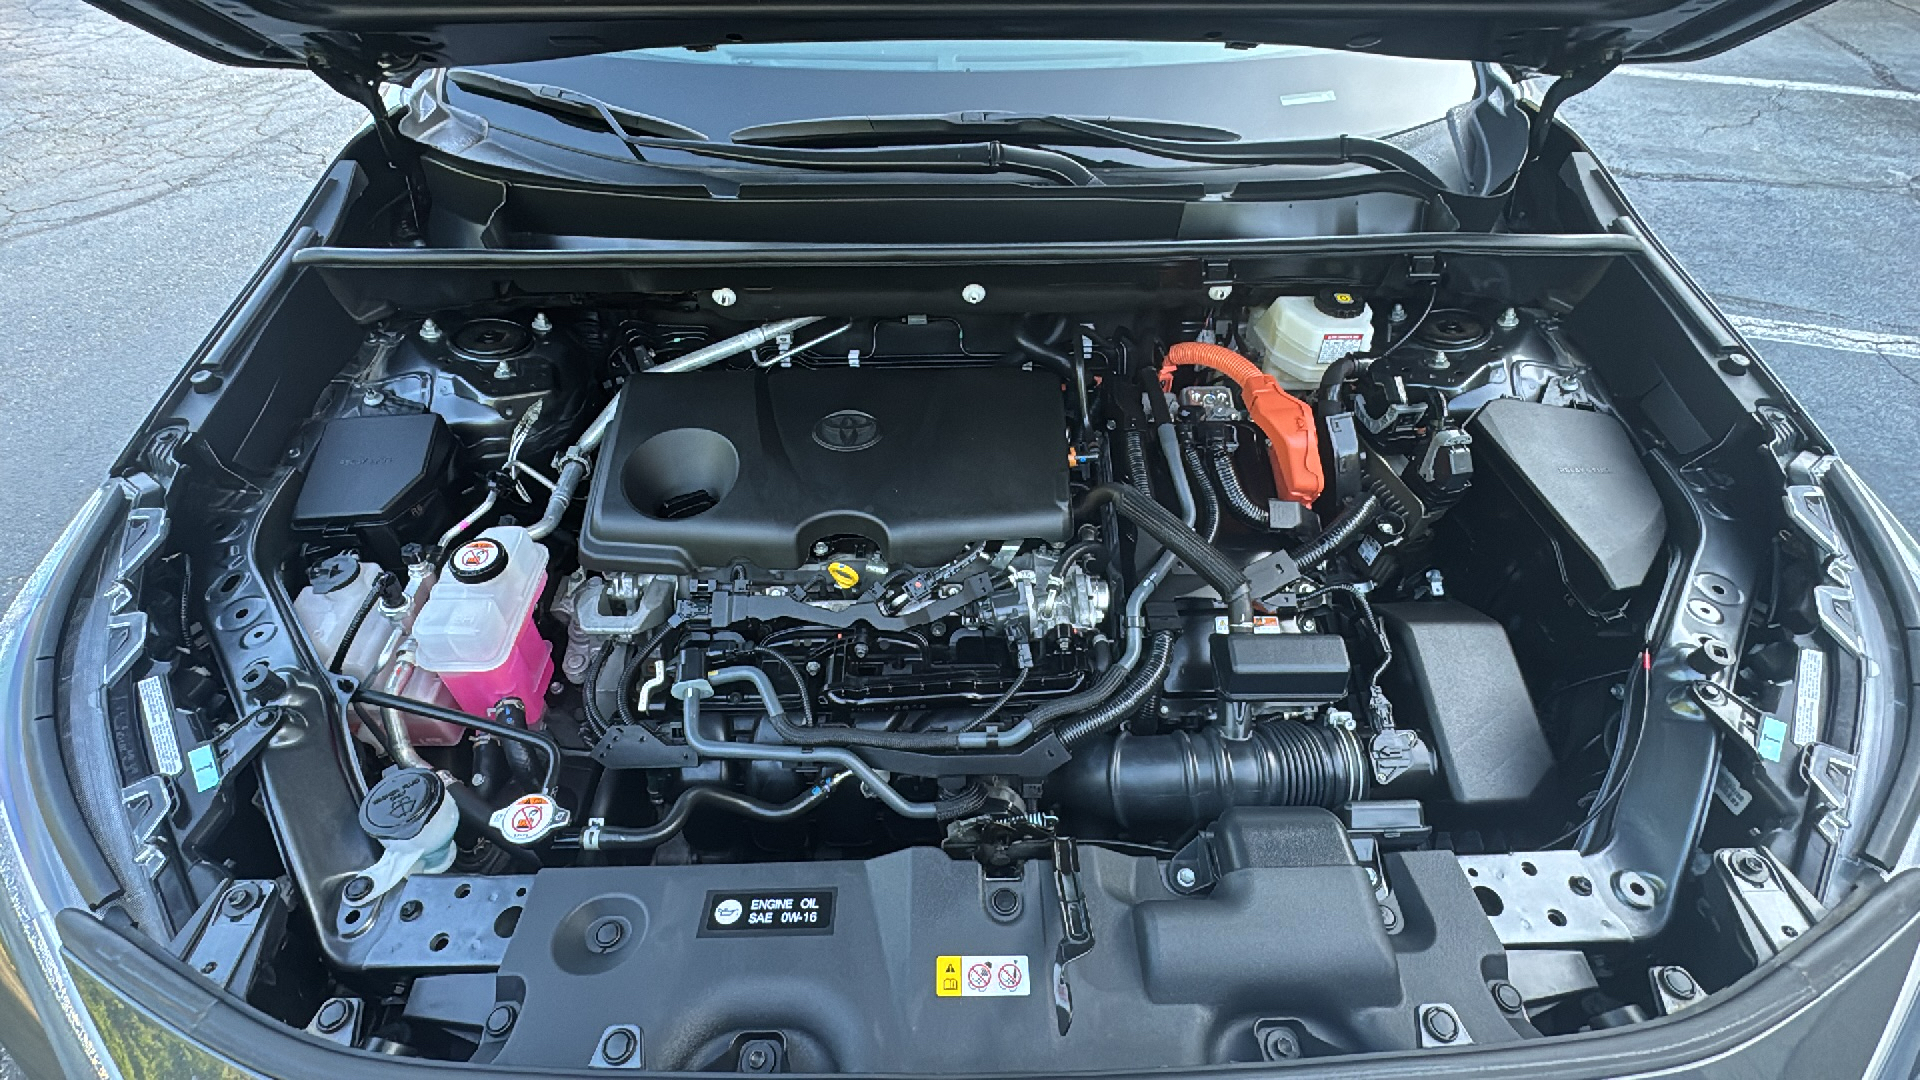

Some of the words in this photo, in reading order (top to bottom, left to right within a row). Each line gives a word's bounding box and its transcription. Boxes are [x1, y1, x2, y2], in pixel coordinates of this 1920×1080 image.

[750, 898, 794, 910] ENGINE
[800, 897, 819, 909] OIL
[748, 911, 773, 924] SAE
[780, 911, 817, 923] 0W-16
